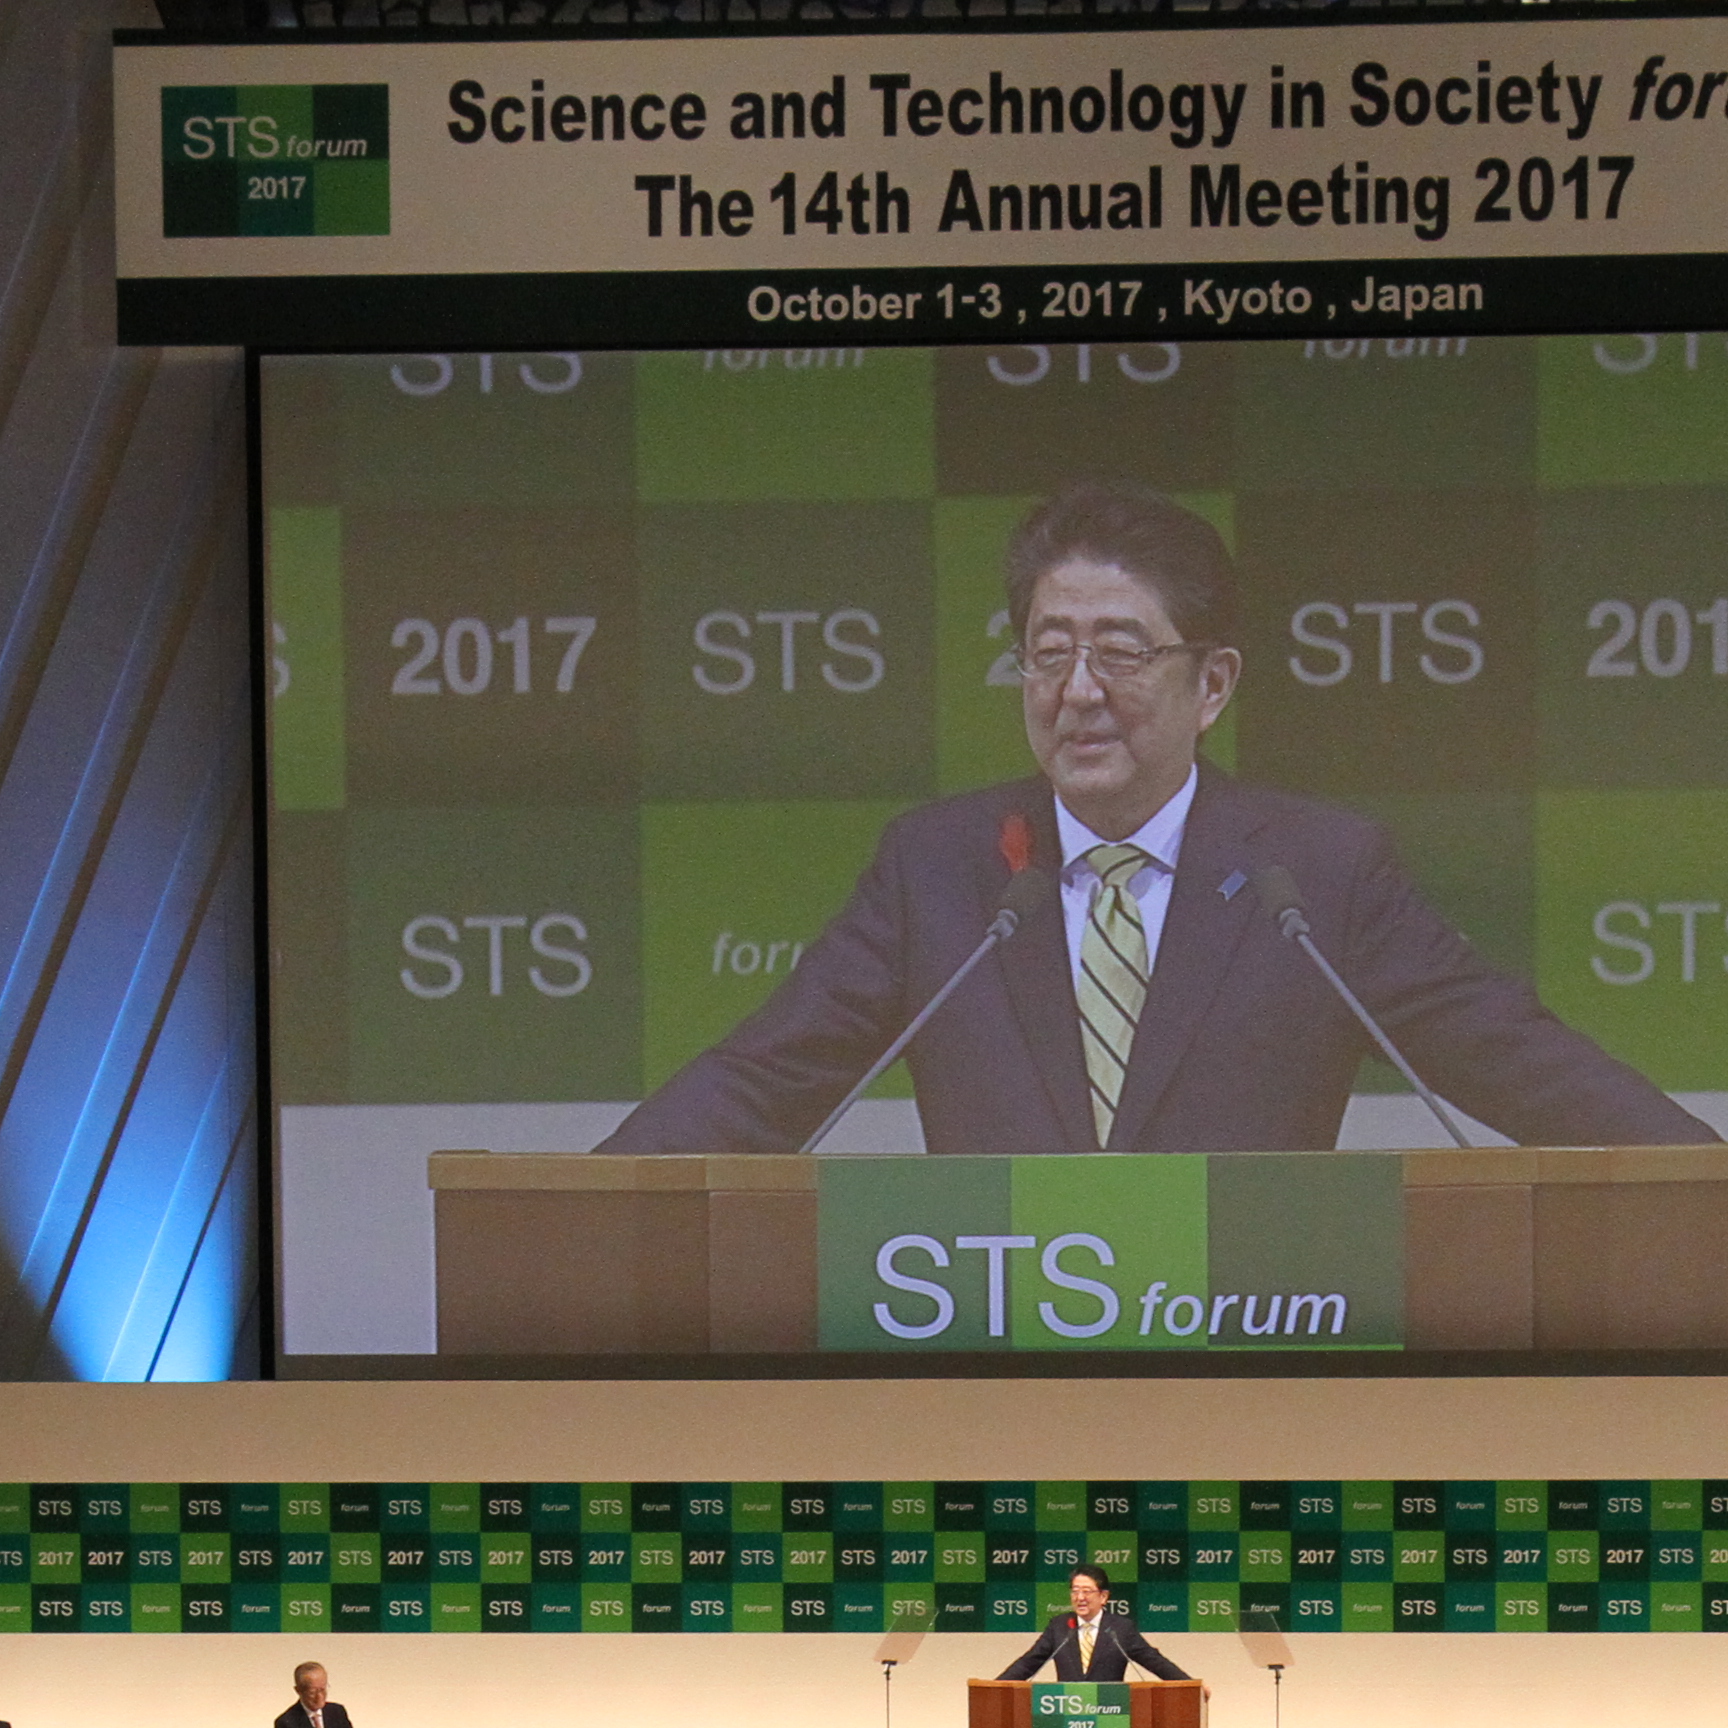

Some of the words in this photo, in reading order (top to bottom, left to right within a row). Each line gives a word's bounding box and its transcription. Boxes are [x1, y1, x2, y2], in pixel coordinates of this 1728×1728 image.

[448, 80, 706, 143] Science
[731, 75, 845, 139] and
[870, 69, 1246, 148] Technology
[1272, 66, 1324, 128] in
[1351, 61, 1602, 140] Society
[184, 116, 280, 159] STS
[287, 135, 367, 157] forum
[249, 177, 305, 199] 2017
[635, 175, 753, 236] The
[771, 172, 909, 234] 14th
[939, 166, 1162, 231] Annual
[1191, 162, 1449, 240] Meeting
[1475, 156, 1634, 222] 2017
[748, 286, 922, 321] October
[1352, 277, 1482, 319] Japan
[392, 617, 595, 695] 2017
[693, 610, 883, 695] STS
[1290, 601, 1482, 686] STS
[401, 914, 591, 998] STS
[875, 1233, 1118, 1338] STS
[1140, 1282, 1345, 1335] forum
[39, 1552, 74, 1565] 2017
[88, 1552, 124, 1565] 2017
[139, 1551, 172, 1565] STS
[188, 1551, 224, 1565] 2017
[239, 1550, 272, 1565] STS
[288, 1551, 323, 1565] 2017
[339, 1551, 372, 1565] STS
[388, 1551, 423, 1565] 2017
[439, 1550, 472, 1565] STS
[488, 1551, 524, 1565] 2017
[540, 1550, 573, 1565] STS
[589, 1551, 624, 1564] 2017
[640, 1550, 673, 1565] STS
[689, 1551, 725, 1564] 2017
[741, 1550, 774, 1565] STS
[790, 1551, 826, 1564] 2017
[842, 1550, 875, 1565] STS
[892, 1550, 927, 1564] 2017
[943, 1550, 976, 1564] STS
[993, 1550, 1029, 1563] 2017
[1045, 1549, 1078, 1564] STS
[1095, 1550, 1131, 1563] 2017
[1146, 1549, 1180, 1564] STS
[1197, 1550, 1233, 1563] 2017
[1248, 1549, 1282, 1564] STS
[1299, 1550, 1335, 1563] 2017
[1351, 1549, 1385, 1564] STS
[1401, 1550, 1437, 1563] 2017
[1453, 1549, 1487, 1564] STS
[1504, 1550, 1540, 1563] 2017
[1556, 1549, 1590, 1564] STS
[1607, 1550, 1643, 1563] 2017
[1659, 1549, 1694, 1564] STS
[1040, 1695, 1083, 1714] STS
[1085, 1703, 1121, 1714] forum
